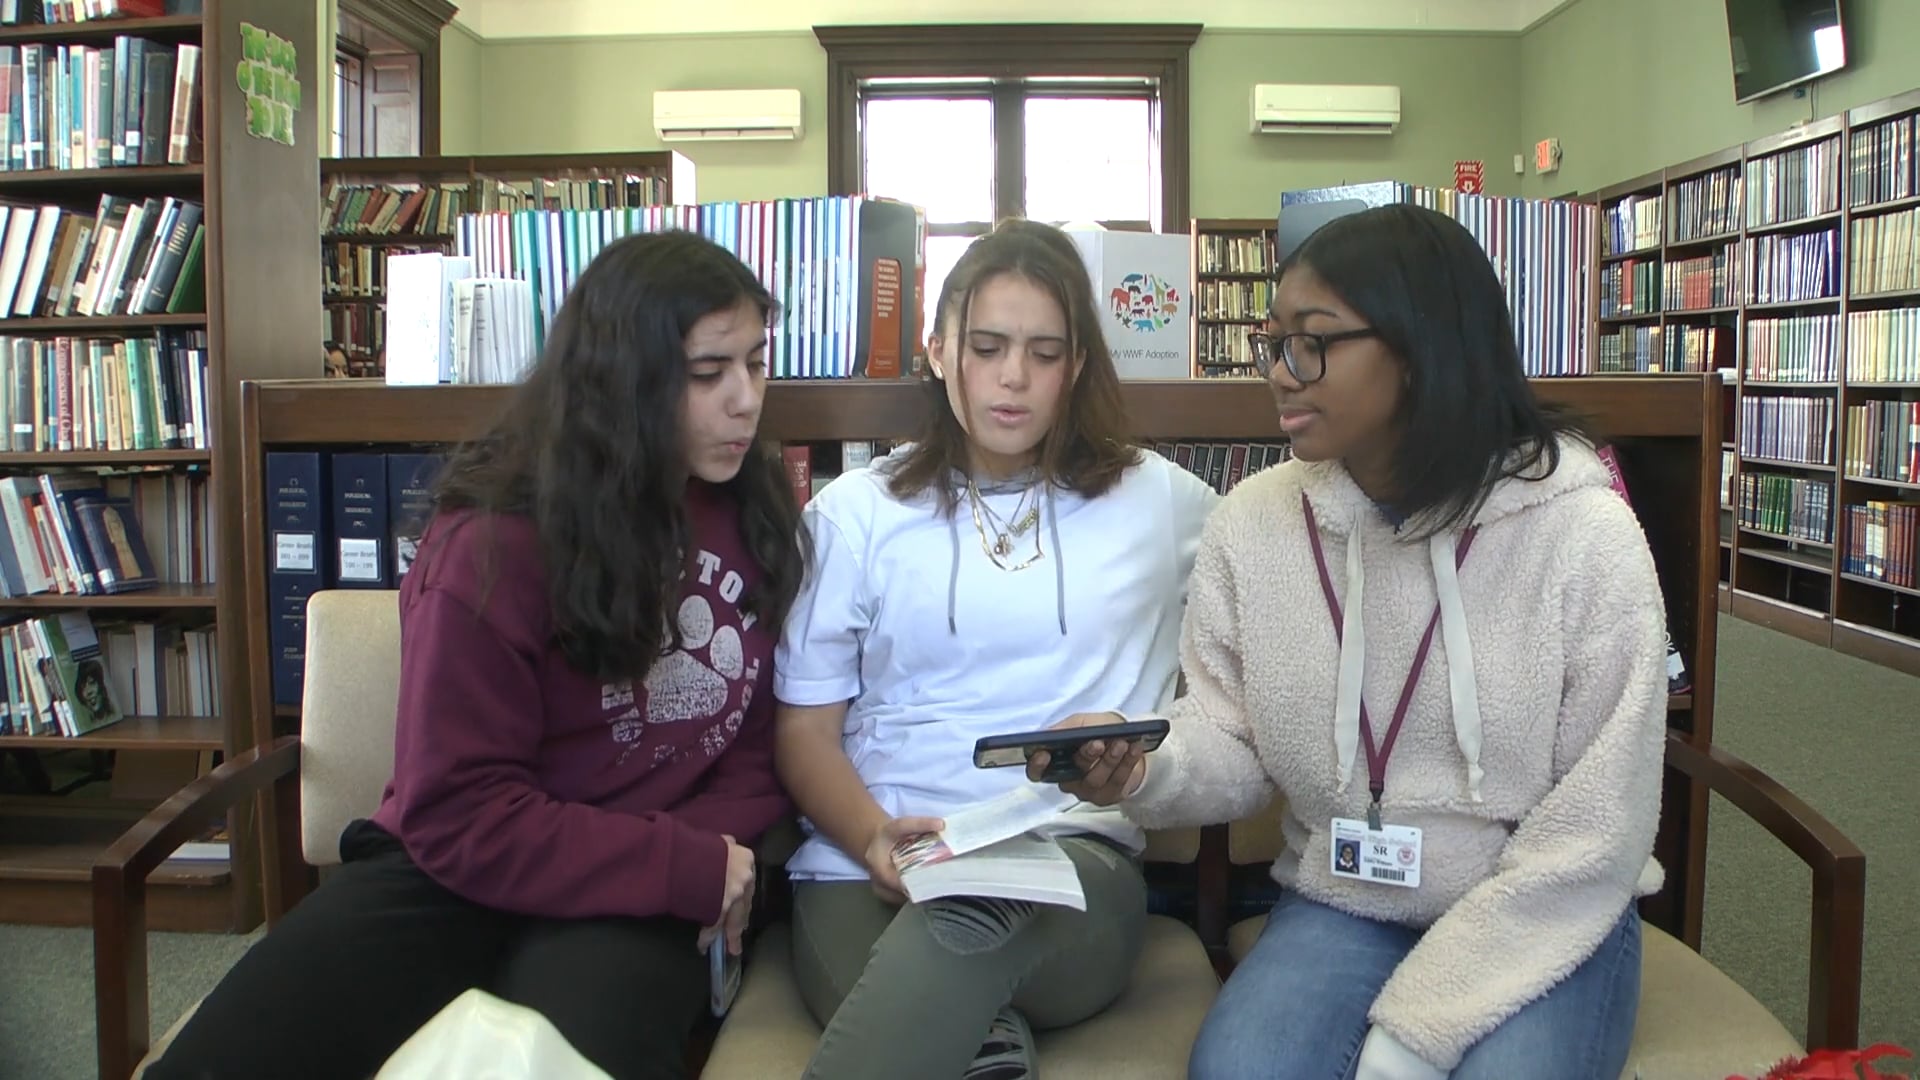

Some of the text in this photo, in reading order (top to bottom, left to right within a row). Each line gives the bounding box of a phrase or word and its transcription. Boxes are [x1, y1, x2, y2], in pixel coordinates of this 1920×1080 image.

[1460, 164, 1478, 172] FIRE
[1122, 349, 1144, 359] WWF
[1145, 349, 1179, 360] Adoption
[1372, 845, 1388, 856] SR
